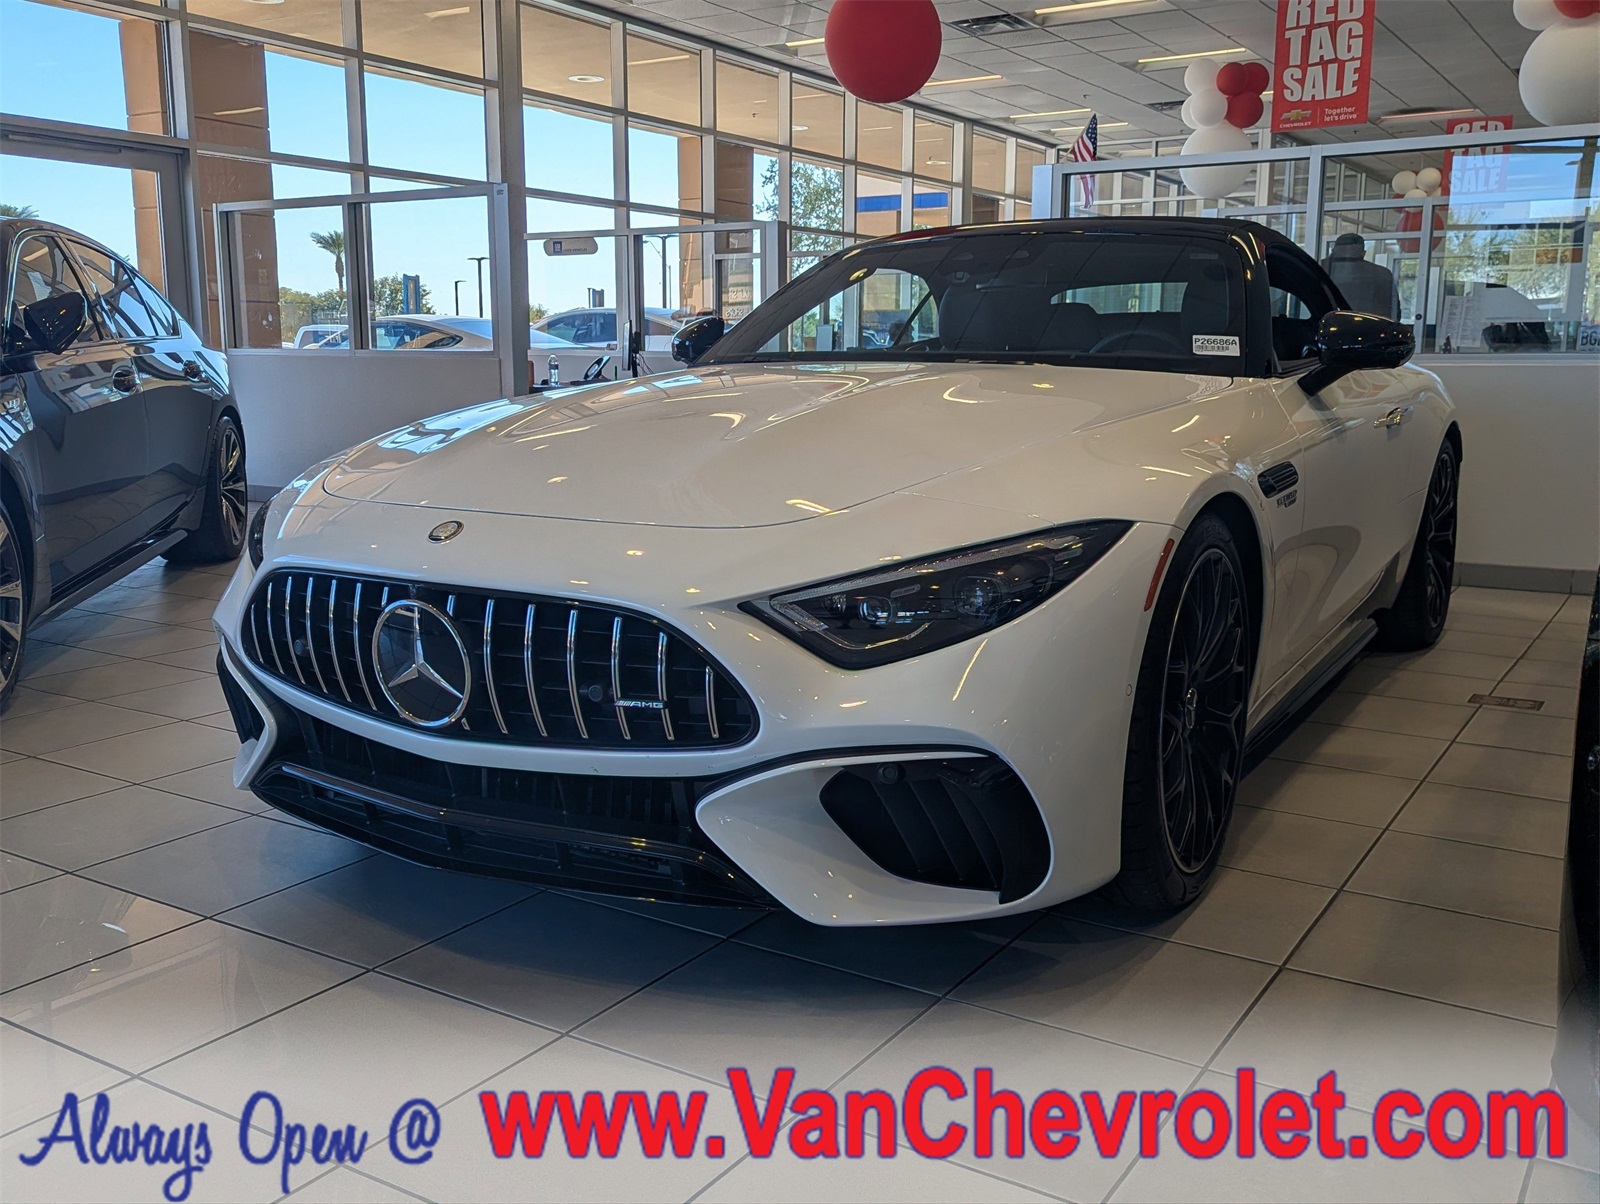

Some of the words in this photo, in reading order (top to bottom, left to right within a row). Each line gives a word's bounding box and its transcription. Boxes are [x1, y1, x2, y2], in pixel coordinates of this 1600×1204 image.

[1285, 0, 1365, 28] RED
[1285, 21, 1364, 66] TAG
[1283, 60, 1361, 102] SALE
[1324, 107, 1356, 117] Together
[1324, 114, 1339, 122] let's
[1451, 145, 1504, 170] TAG
[1449, 168, 1501, 193] SALE
[1194, 338, 1237, 346] P26686A
[1581, 331, 1600, 346] BG
[629, 701, 663, 709] AMG
